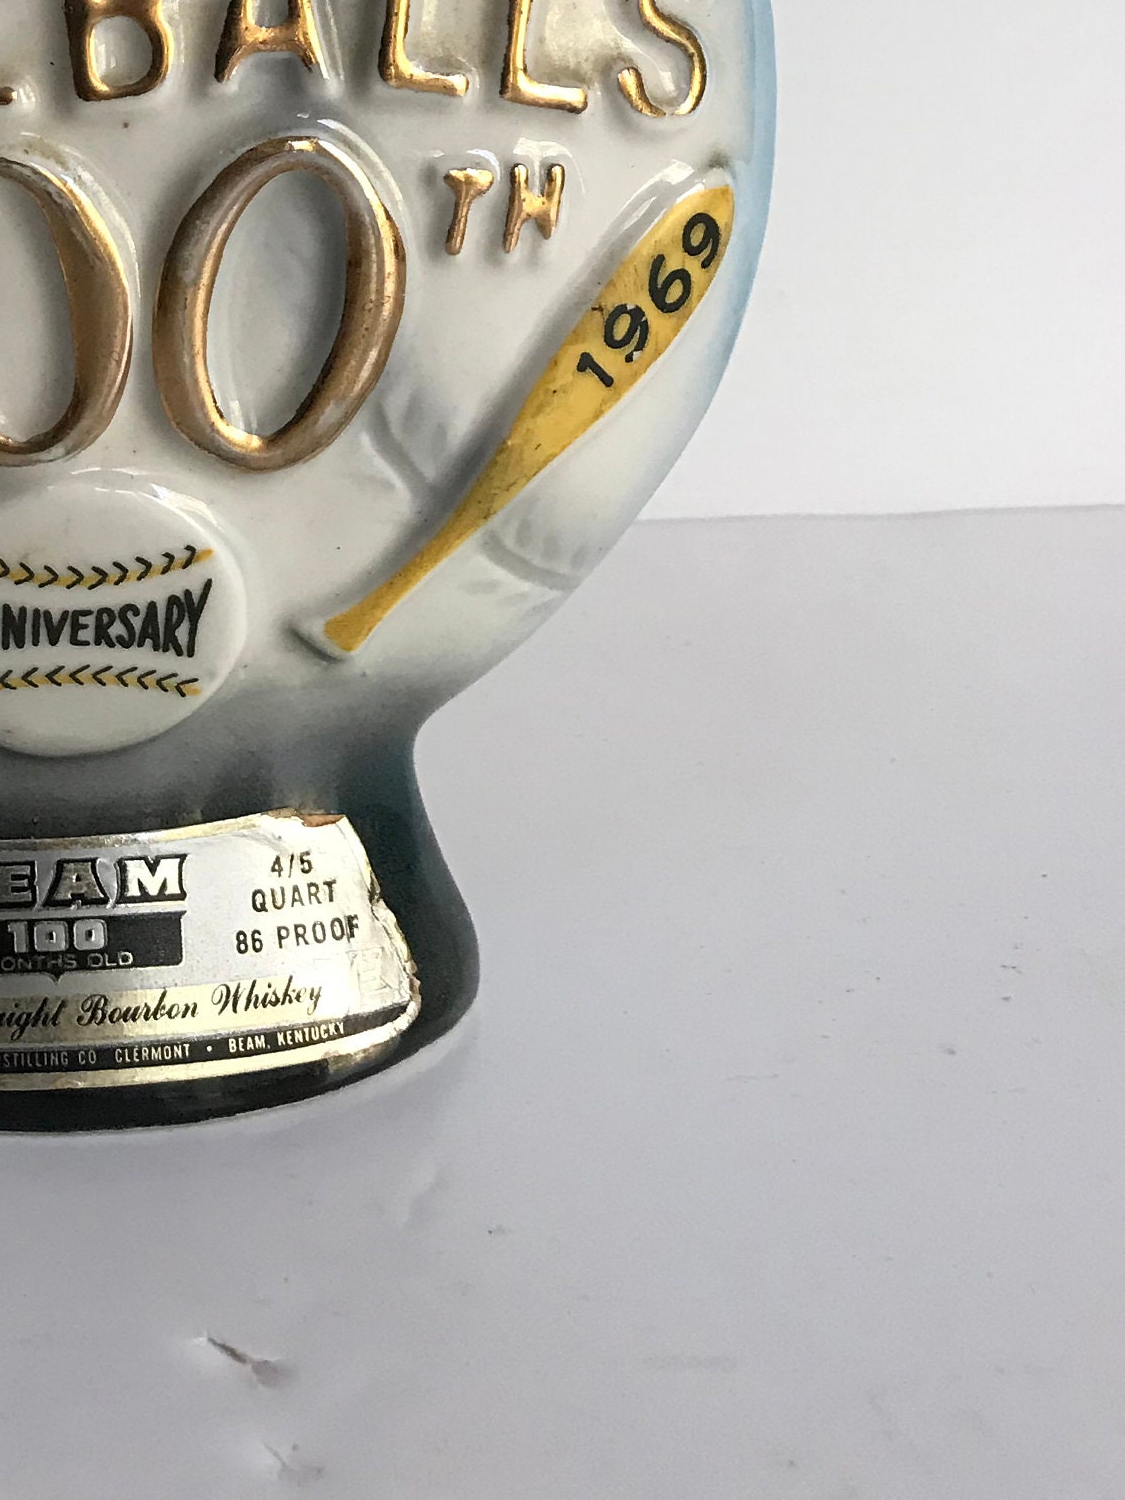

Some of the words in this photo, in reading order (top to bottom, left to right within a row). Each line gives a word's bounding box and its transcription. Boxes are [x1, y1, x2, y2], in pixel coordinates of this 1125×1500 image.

[574, 211, 725, 388] 1969
[270, 851, 313, 878] 4/5
[251, 879, 337, 912] QUART
[7, 918, 108, 953] 100
[235, 929, 263, 954] 86
[276, 914, 359, 949] PROOF
[87, 951, 134, 968] OLD
[76, 987, 199, 1027] Bourbon
[211, 974, 323, 1016] Whiskey
[115, 1043, 191, 1063] CLERMONT
[277, 1022, 345, 1047] KENTUCKY
